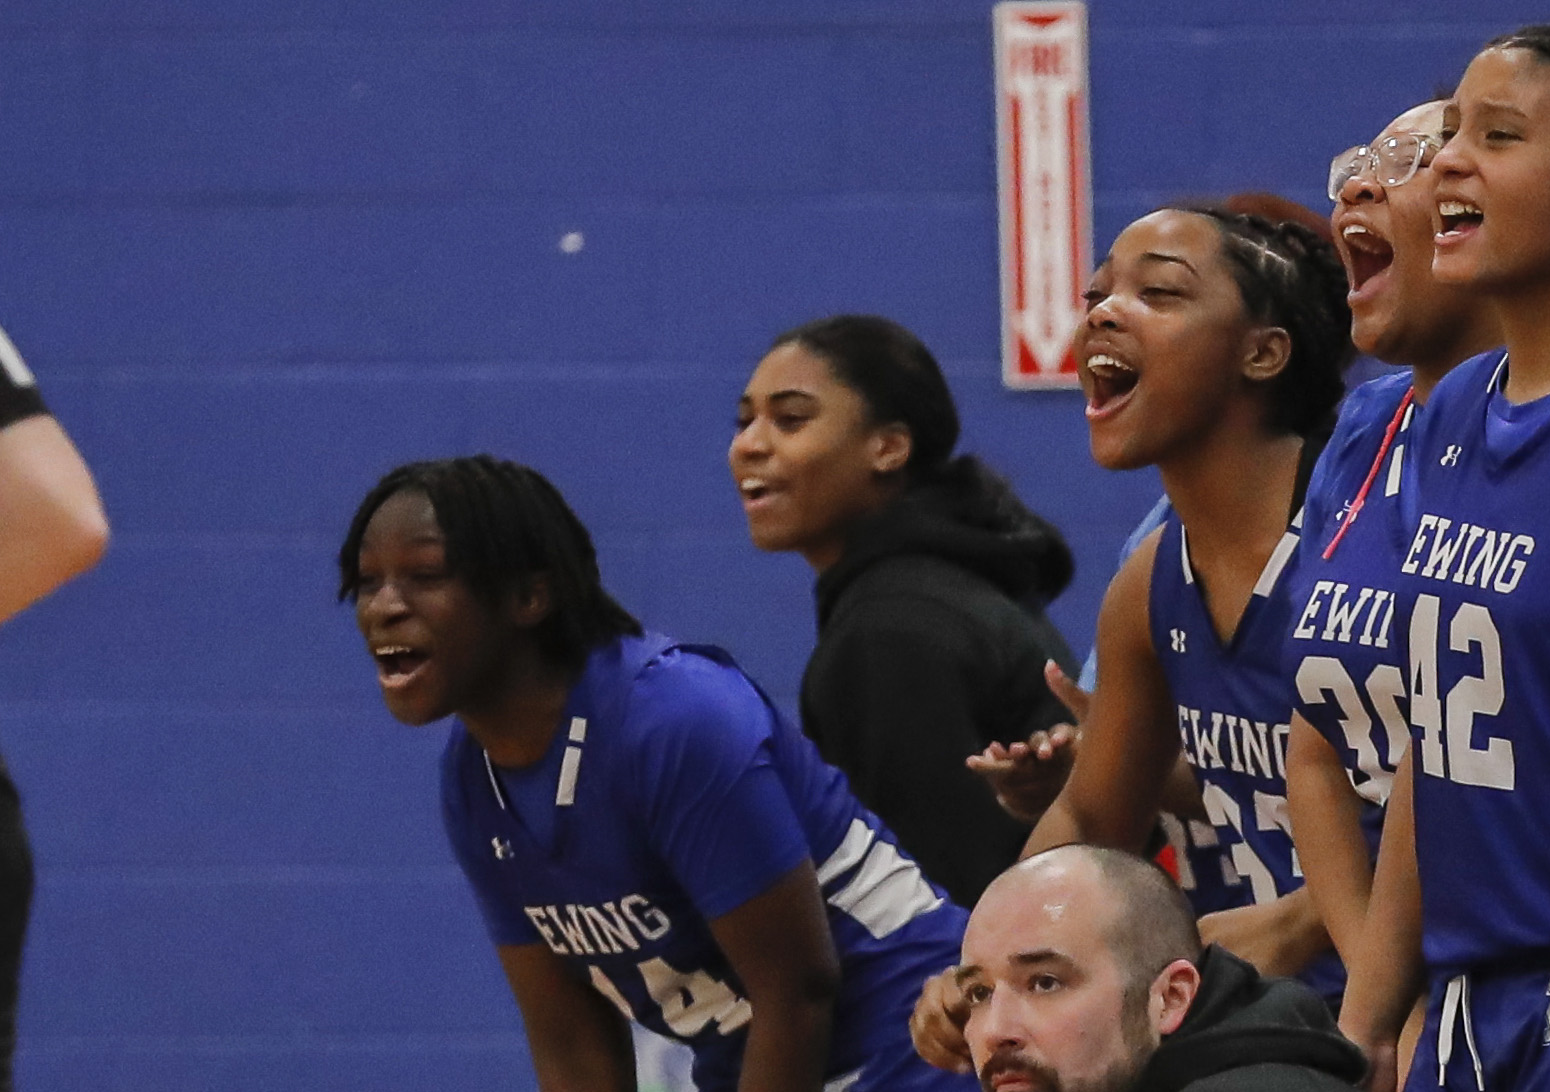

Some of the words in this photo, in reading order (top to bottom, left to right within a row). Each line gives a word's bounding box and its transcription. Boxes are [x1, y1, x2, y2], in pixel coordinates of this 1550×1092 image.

[1402, 513, 1536, 595] EWING
[1408, 593, 1516, 792] 42
[523, 892, 672, 957] EWING
